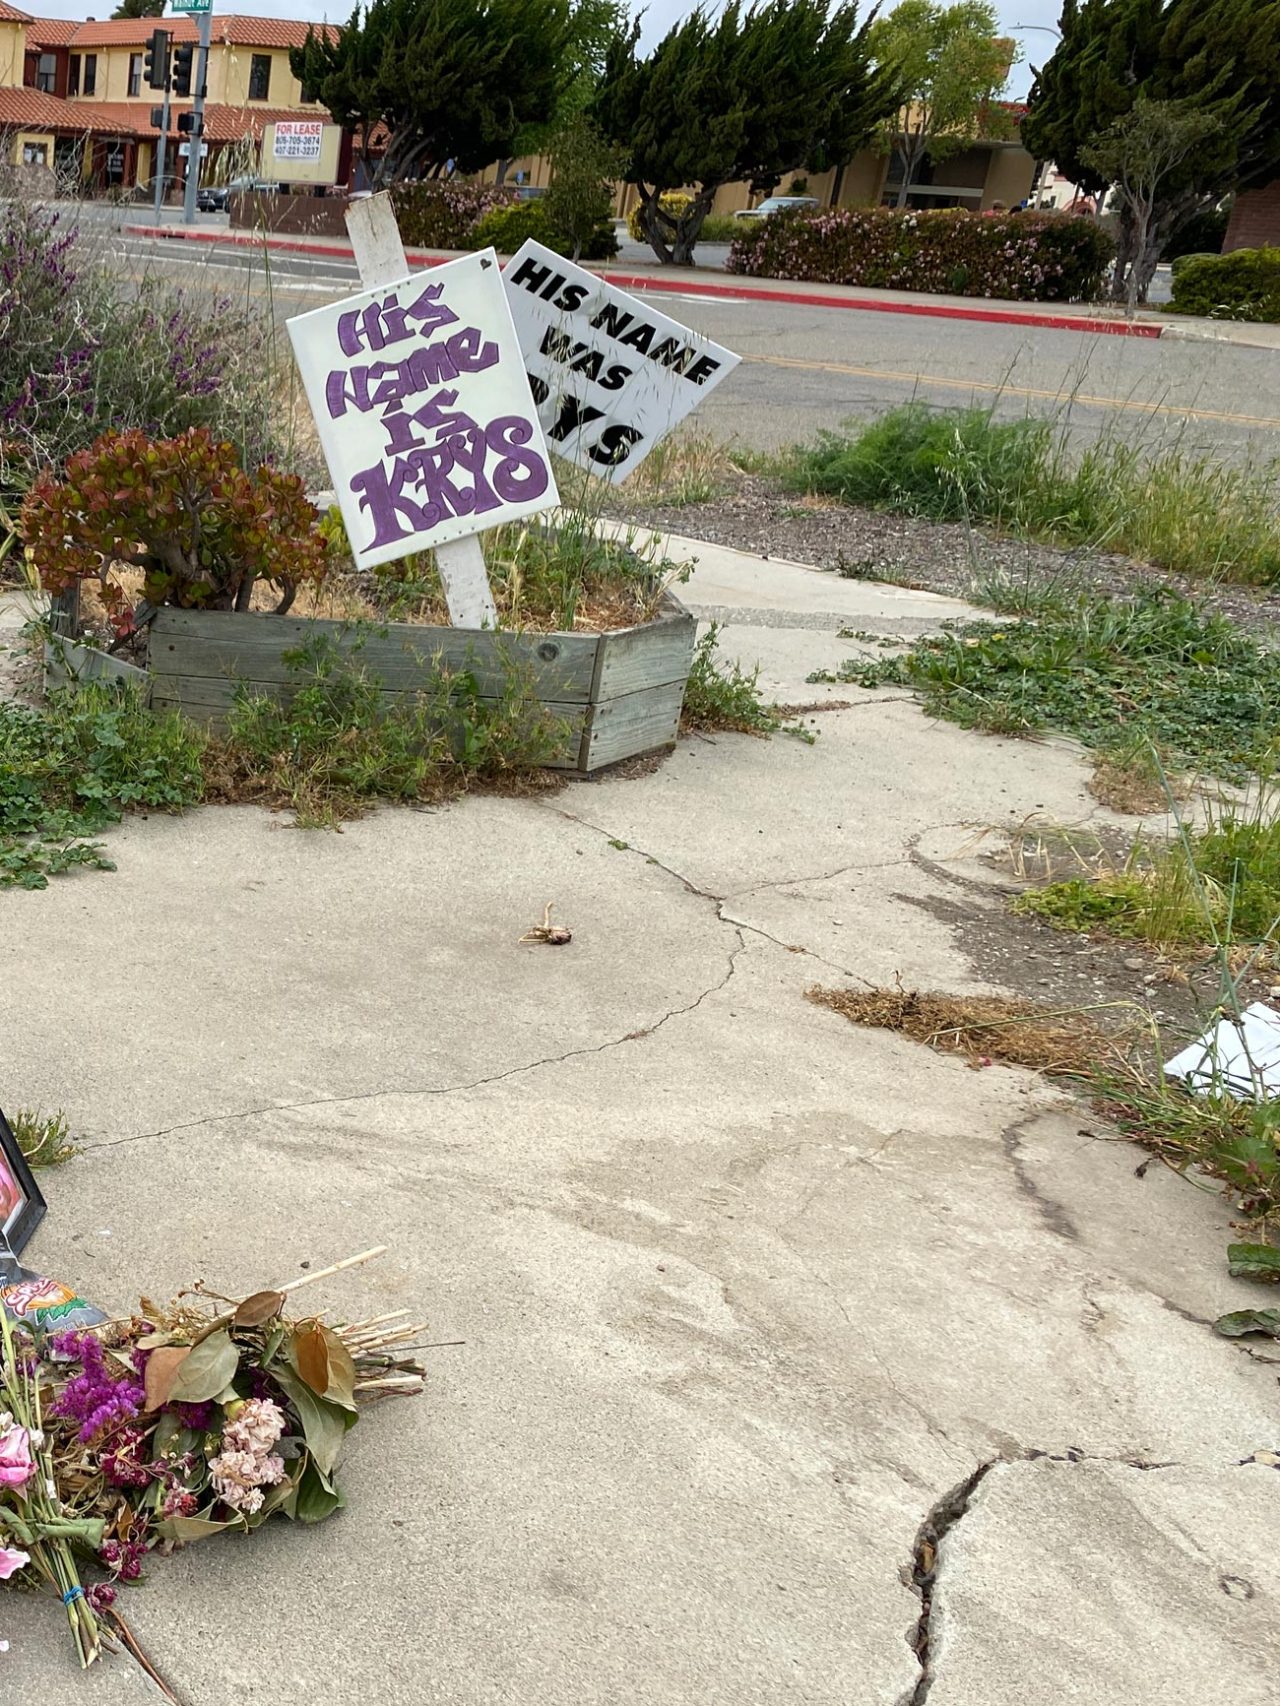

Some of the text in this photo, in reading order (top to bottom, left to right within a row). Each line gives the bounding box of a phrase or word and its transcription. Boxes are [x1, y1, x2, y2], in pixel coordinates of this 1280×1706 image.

[276, 124, 321, 135] FOR LEASE
[510, 257, 721, 386] HIS NAME
[539, 325, 633, 390] WAS
[349, 415, 549, 555] KRYS
